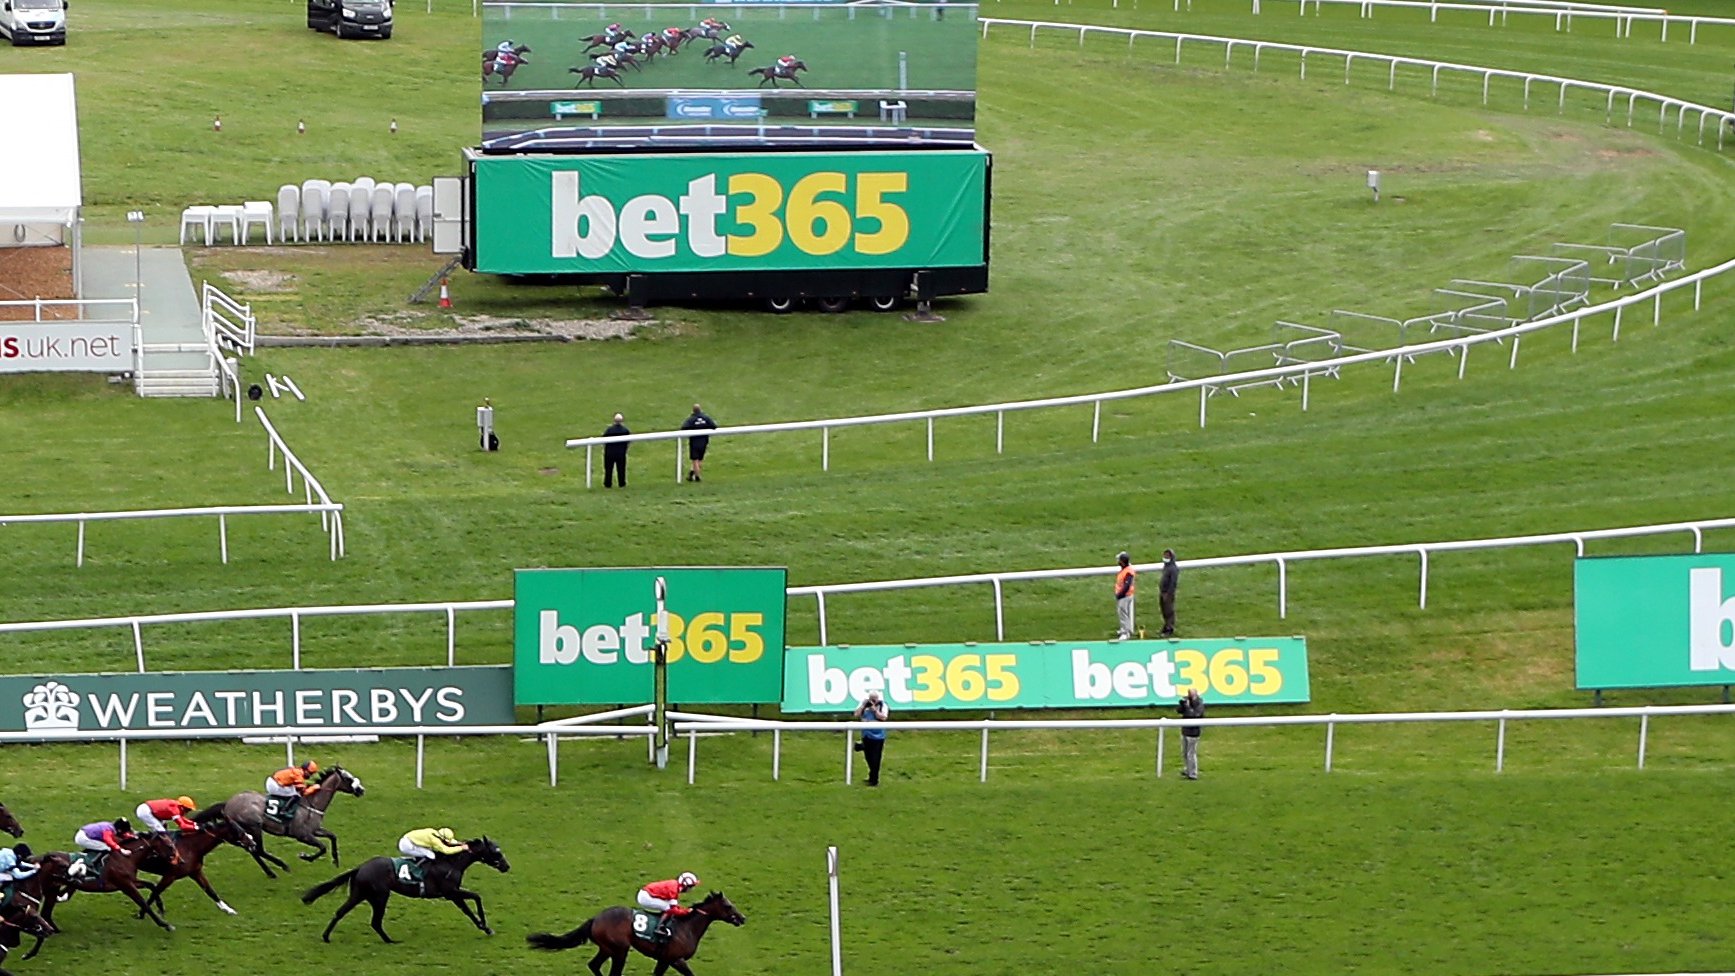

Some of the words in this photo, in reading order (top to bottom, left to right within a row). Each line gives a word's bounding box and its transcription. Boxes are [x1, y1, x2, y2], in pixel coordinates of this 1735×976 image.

[551, 171, 909, 258] bet365
[539, 610, 764, 664] bet365
[807, 654, 1020, 704] bet365
[1071, 648, 1282, 700] bet365
[88, 687, 465, 727] WEATHERBYS
[266, 799, 279, 815] 5
[633, 914, 648, 931] 8
